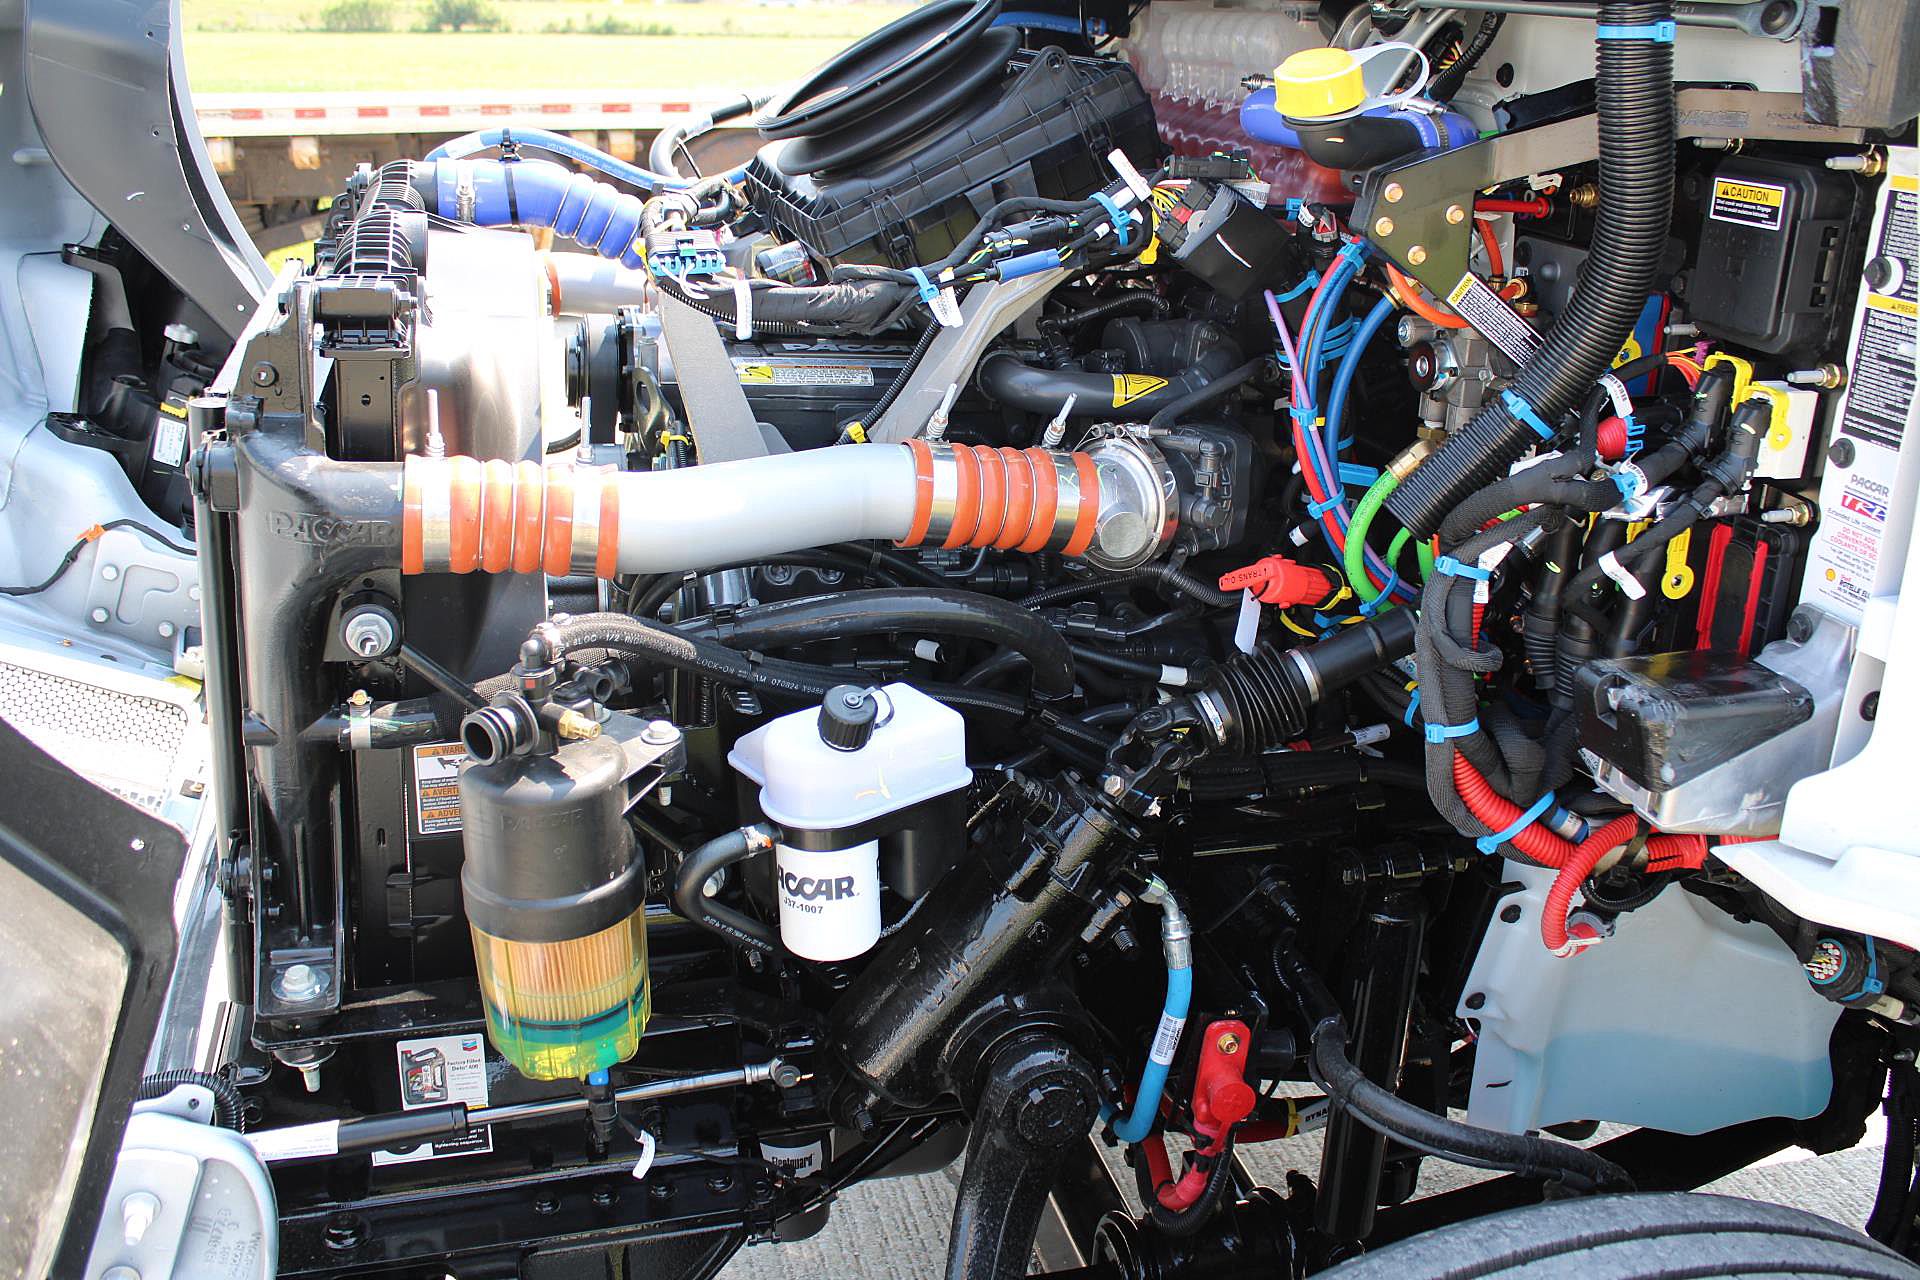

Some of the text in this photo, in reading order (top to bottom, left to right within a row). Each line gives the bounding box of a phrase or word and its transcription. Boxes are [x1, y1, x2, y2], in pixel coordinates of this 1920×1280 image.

[1730, 186, 1769, 202] CAUTION
[1451, 276, 1473, 303] CAUTION
[782, 343, 914, 352] PACCA
[1851, 474, 1889, 497] PACCAR
